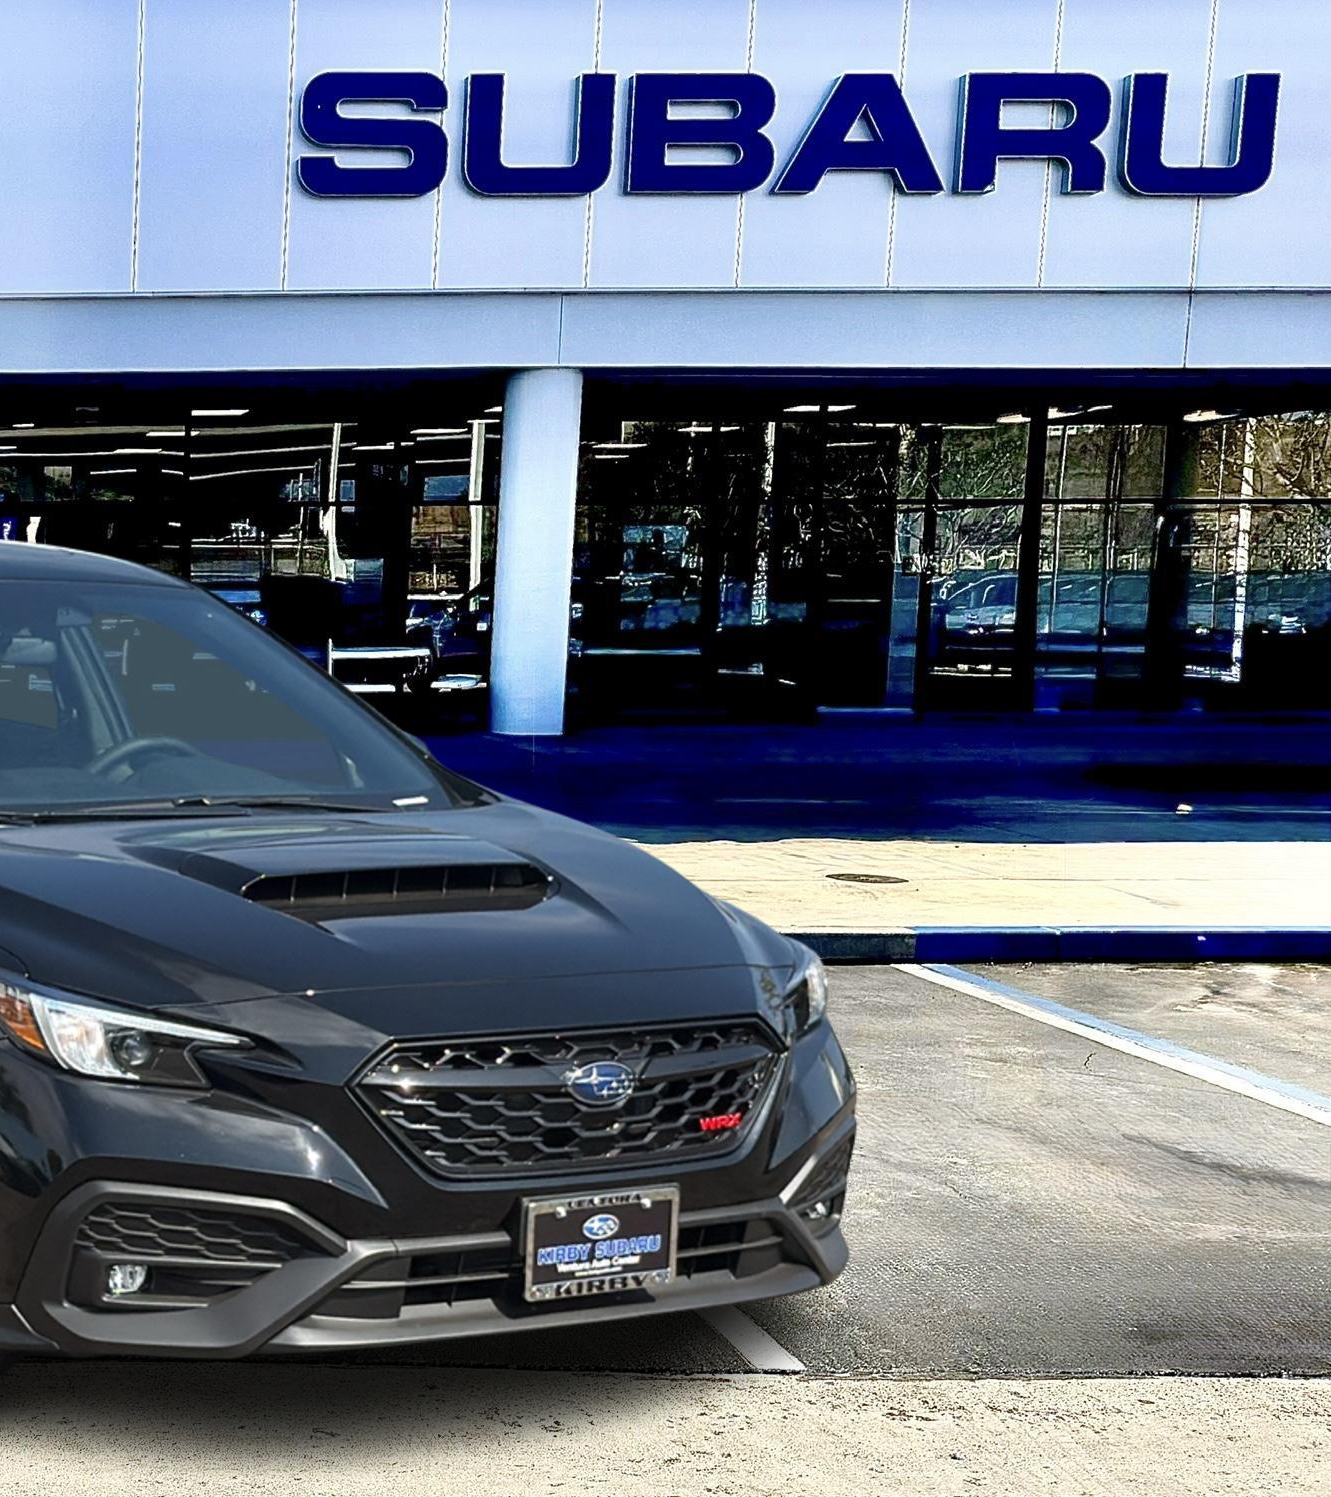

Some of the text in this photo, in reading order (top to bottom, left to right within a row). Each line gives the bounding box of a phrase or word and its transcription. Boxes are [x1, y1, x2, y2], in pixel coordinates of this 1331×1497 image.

[297, 71, 1281, 198] SUBARU
[699, 1112, 742, 1131] WRX
[537, 1234, 661, 1265] KIRBY SUBARU
[555, 1274, 647, 1297] KIRBY
